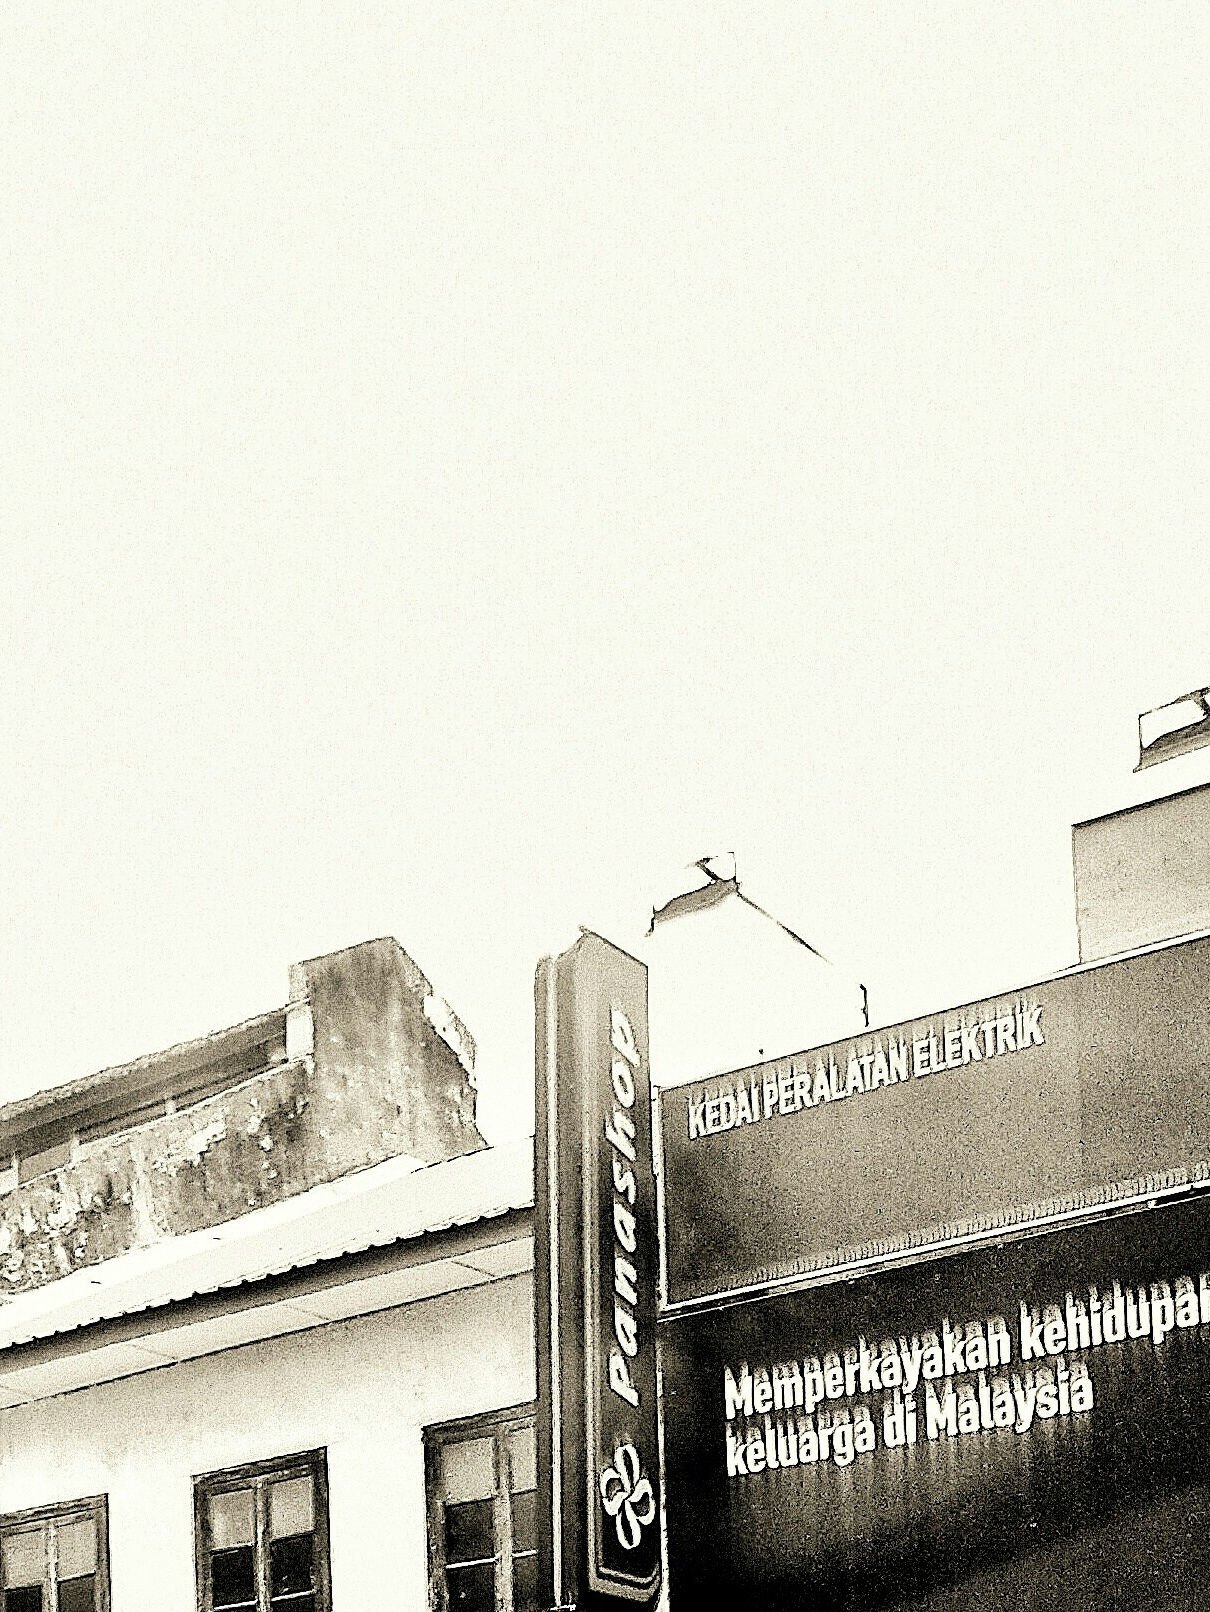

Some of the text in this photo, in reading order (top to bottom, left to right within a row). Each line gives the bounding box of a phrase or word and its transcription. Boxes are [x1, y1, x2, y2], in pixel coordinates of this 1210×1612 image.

[688, 1003, 1045, 1141] KEDAI PERALATAN ELEKTRIK
[605, 1003, 640, 1407] Panashop
[725, 1324, 1011, 1420] Memperkayakan
[726, 1366, 1094, 1477] keluarga di Malaysia
